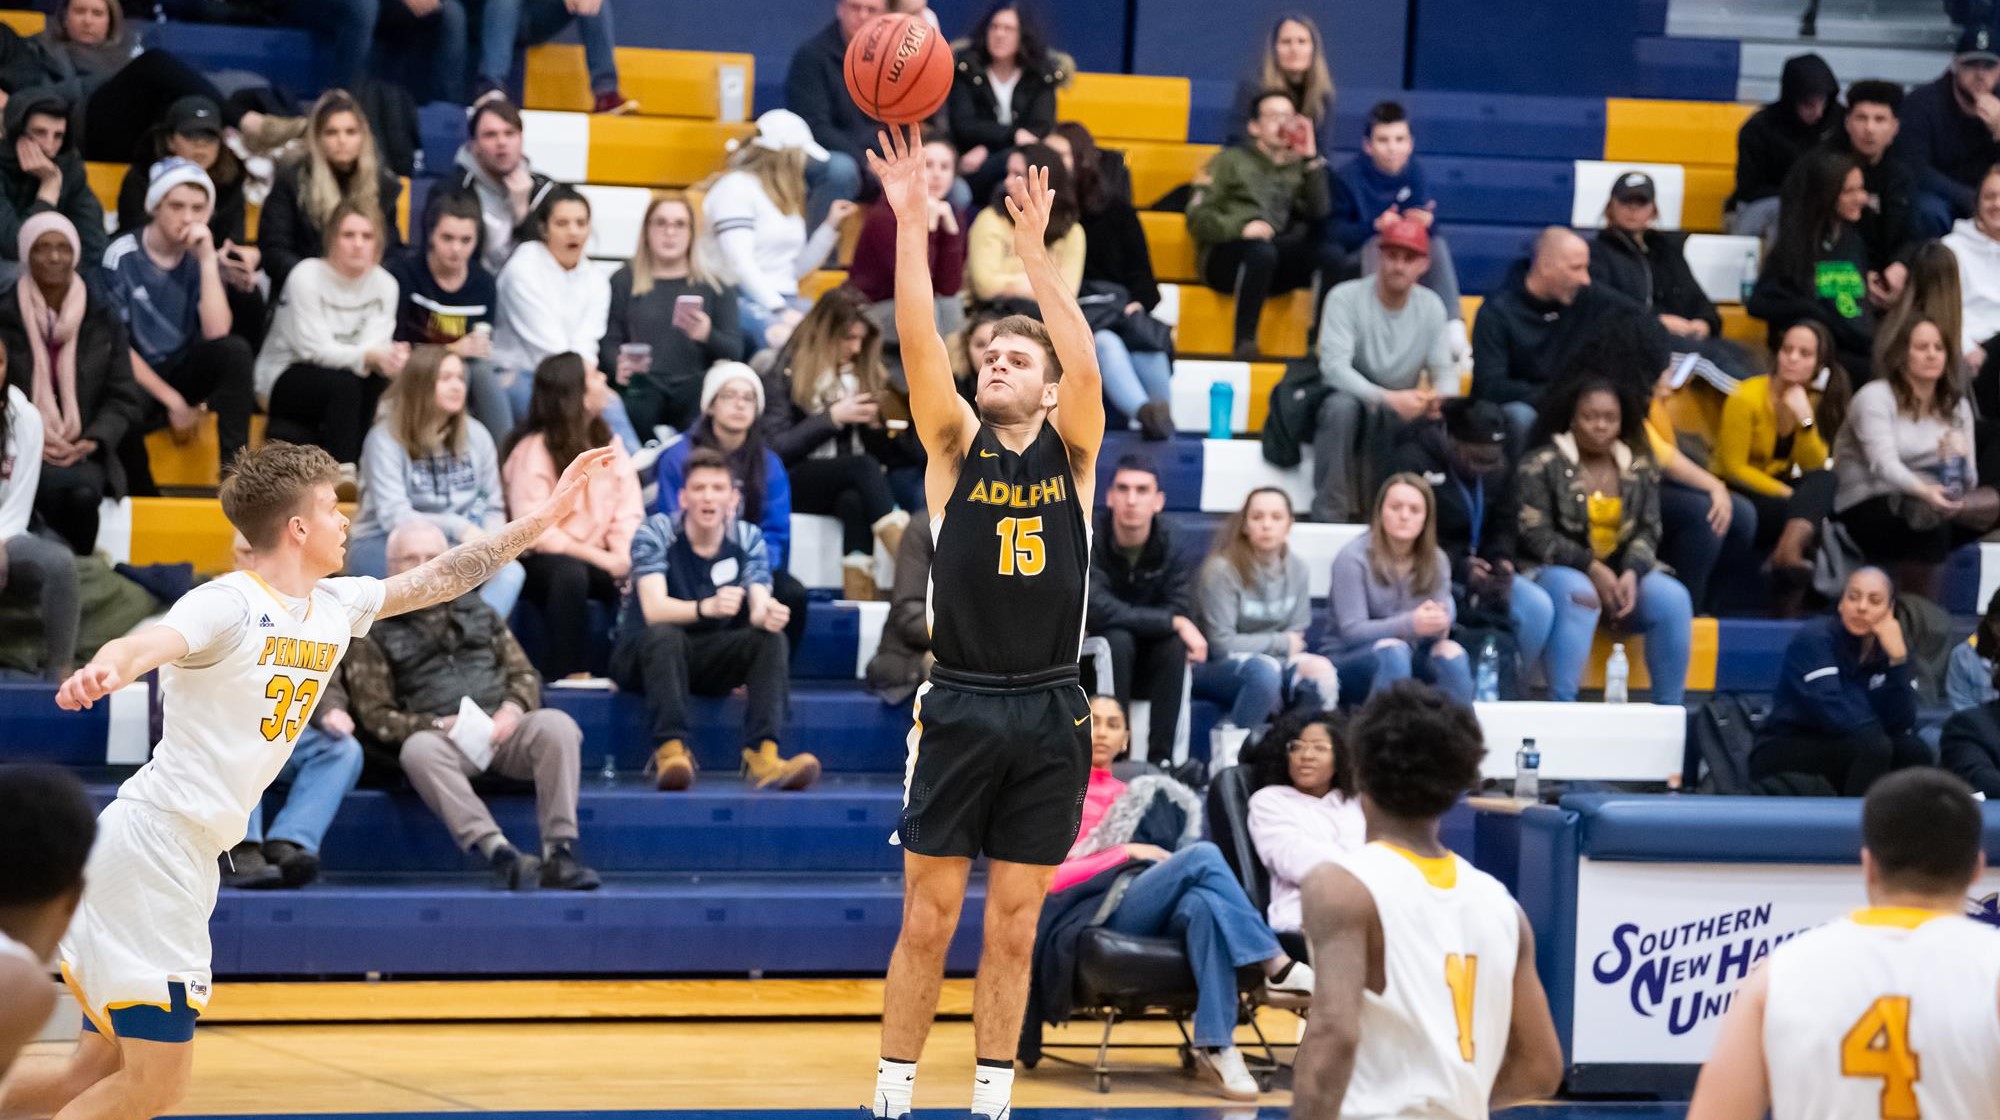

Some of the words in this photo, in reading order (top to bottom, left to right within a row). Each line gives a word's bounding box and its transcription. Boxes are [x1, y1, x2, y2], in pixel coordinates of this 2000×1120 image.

[886, 21, 927, 84] Wilson
[996, 515, 1046, 576] 15
[257, 636, 338, 672] PENMEN
[260, 674, 319, 743] 33
[1593, 903, 1772, 985] SOUTHERN
[1630, 953, 1712, 1017] NEW
[1668, 990, 1739, 1036] UNI
[1840, 993, 1921, 1120] 4
